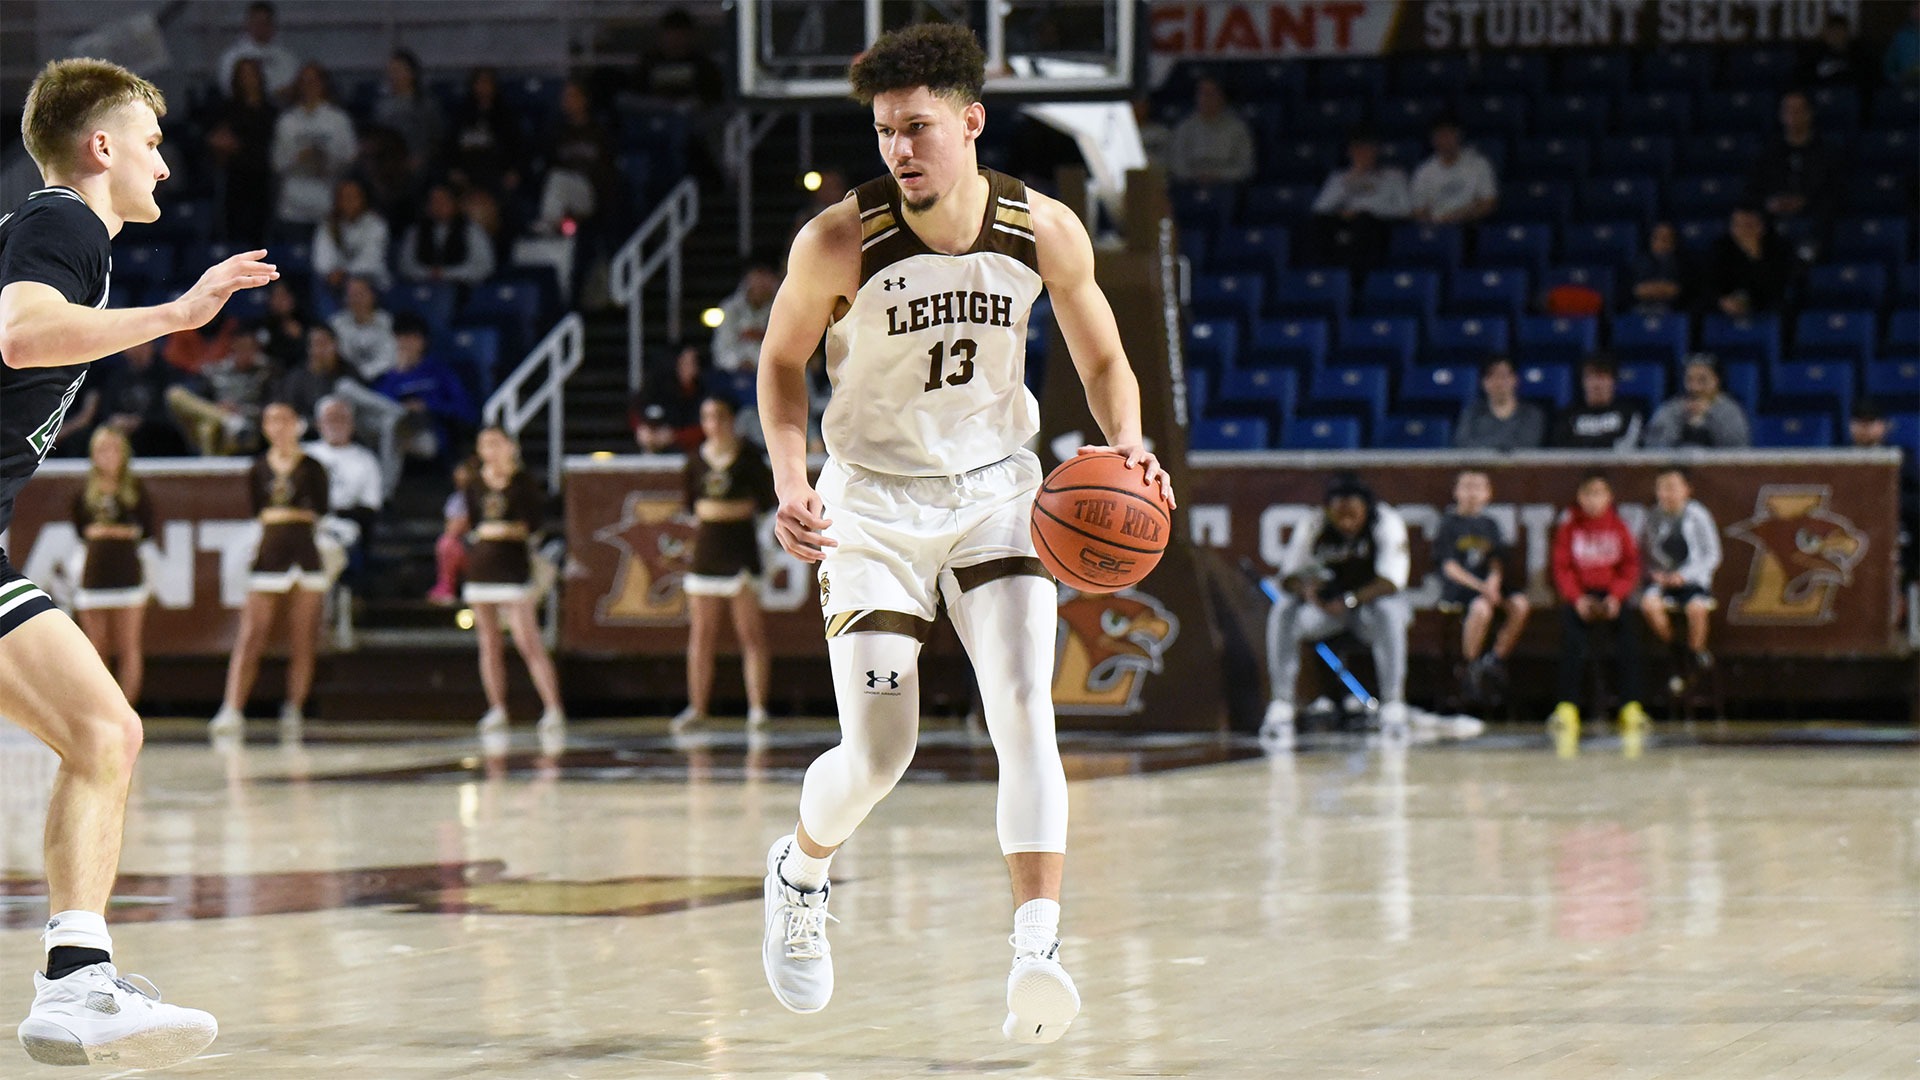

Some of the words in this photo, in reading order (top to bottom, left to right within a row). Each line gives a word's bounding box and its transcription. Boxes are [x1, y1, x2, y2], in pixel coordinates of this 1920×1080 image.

[1149, 4, 1366, 52] GIANT
[1423, 0, 1639, 47] STUDENT
[886, 291, 1013, 336] LEHIGH
[924, 338, 978, 393] 13
[1074, 499, 1117, 530] THE
[1120, 504, 1162, 542] ROCK
